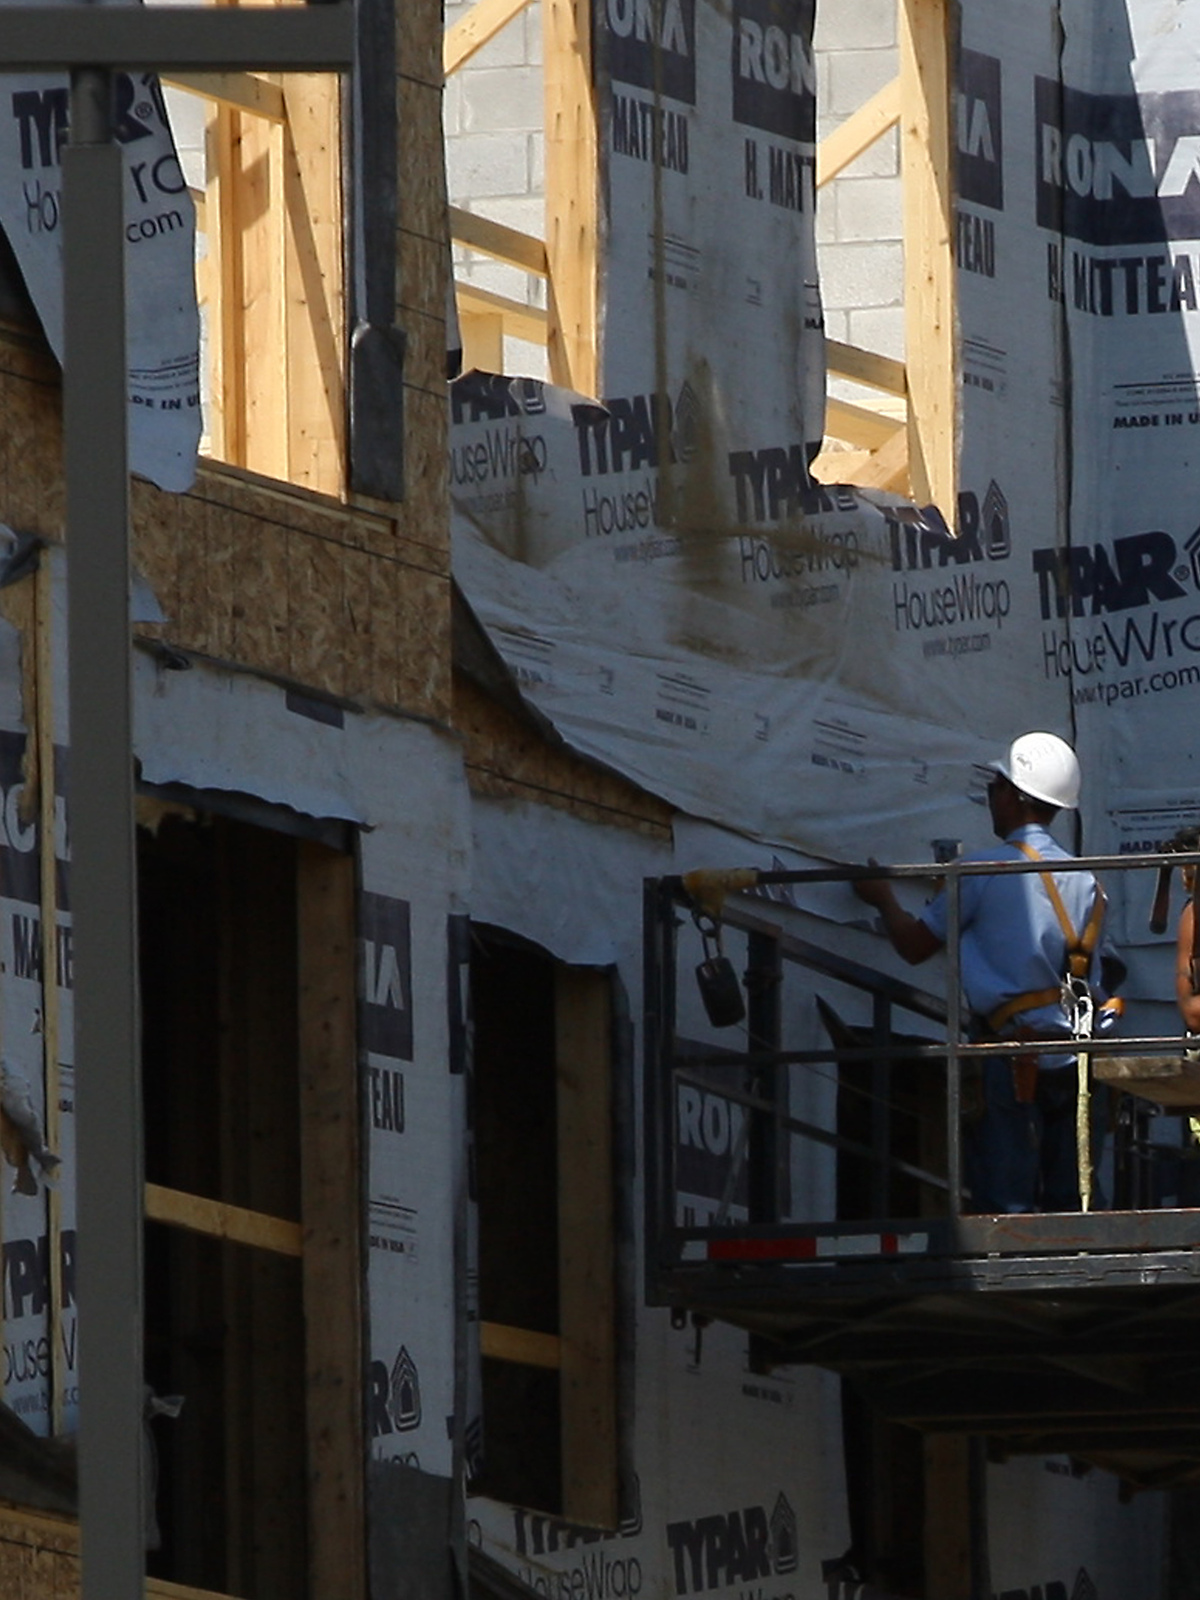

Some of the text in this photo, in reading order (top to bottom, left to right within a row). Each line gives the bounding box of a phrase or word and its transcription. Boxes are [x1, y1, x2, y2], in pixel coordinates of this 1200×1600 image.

[1113, 413, 1159, 429] MADE
[1165, 412, 1184, 426] IN
[892, 572, 1011, 631] HouseWrap
[666, 1505, 771, 1595] TYPAR
